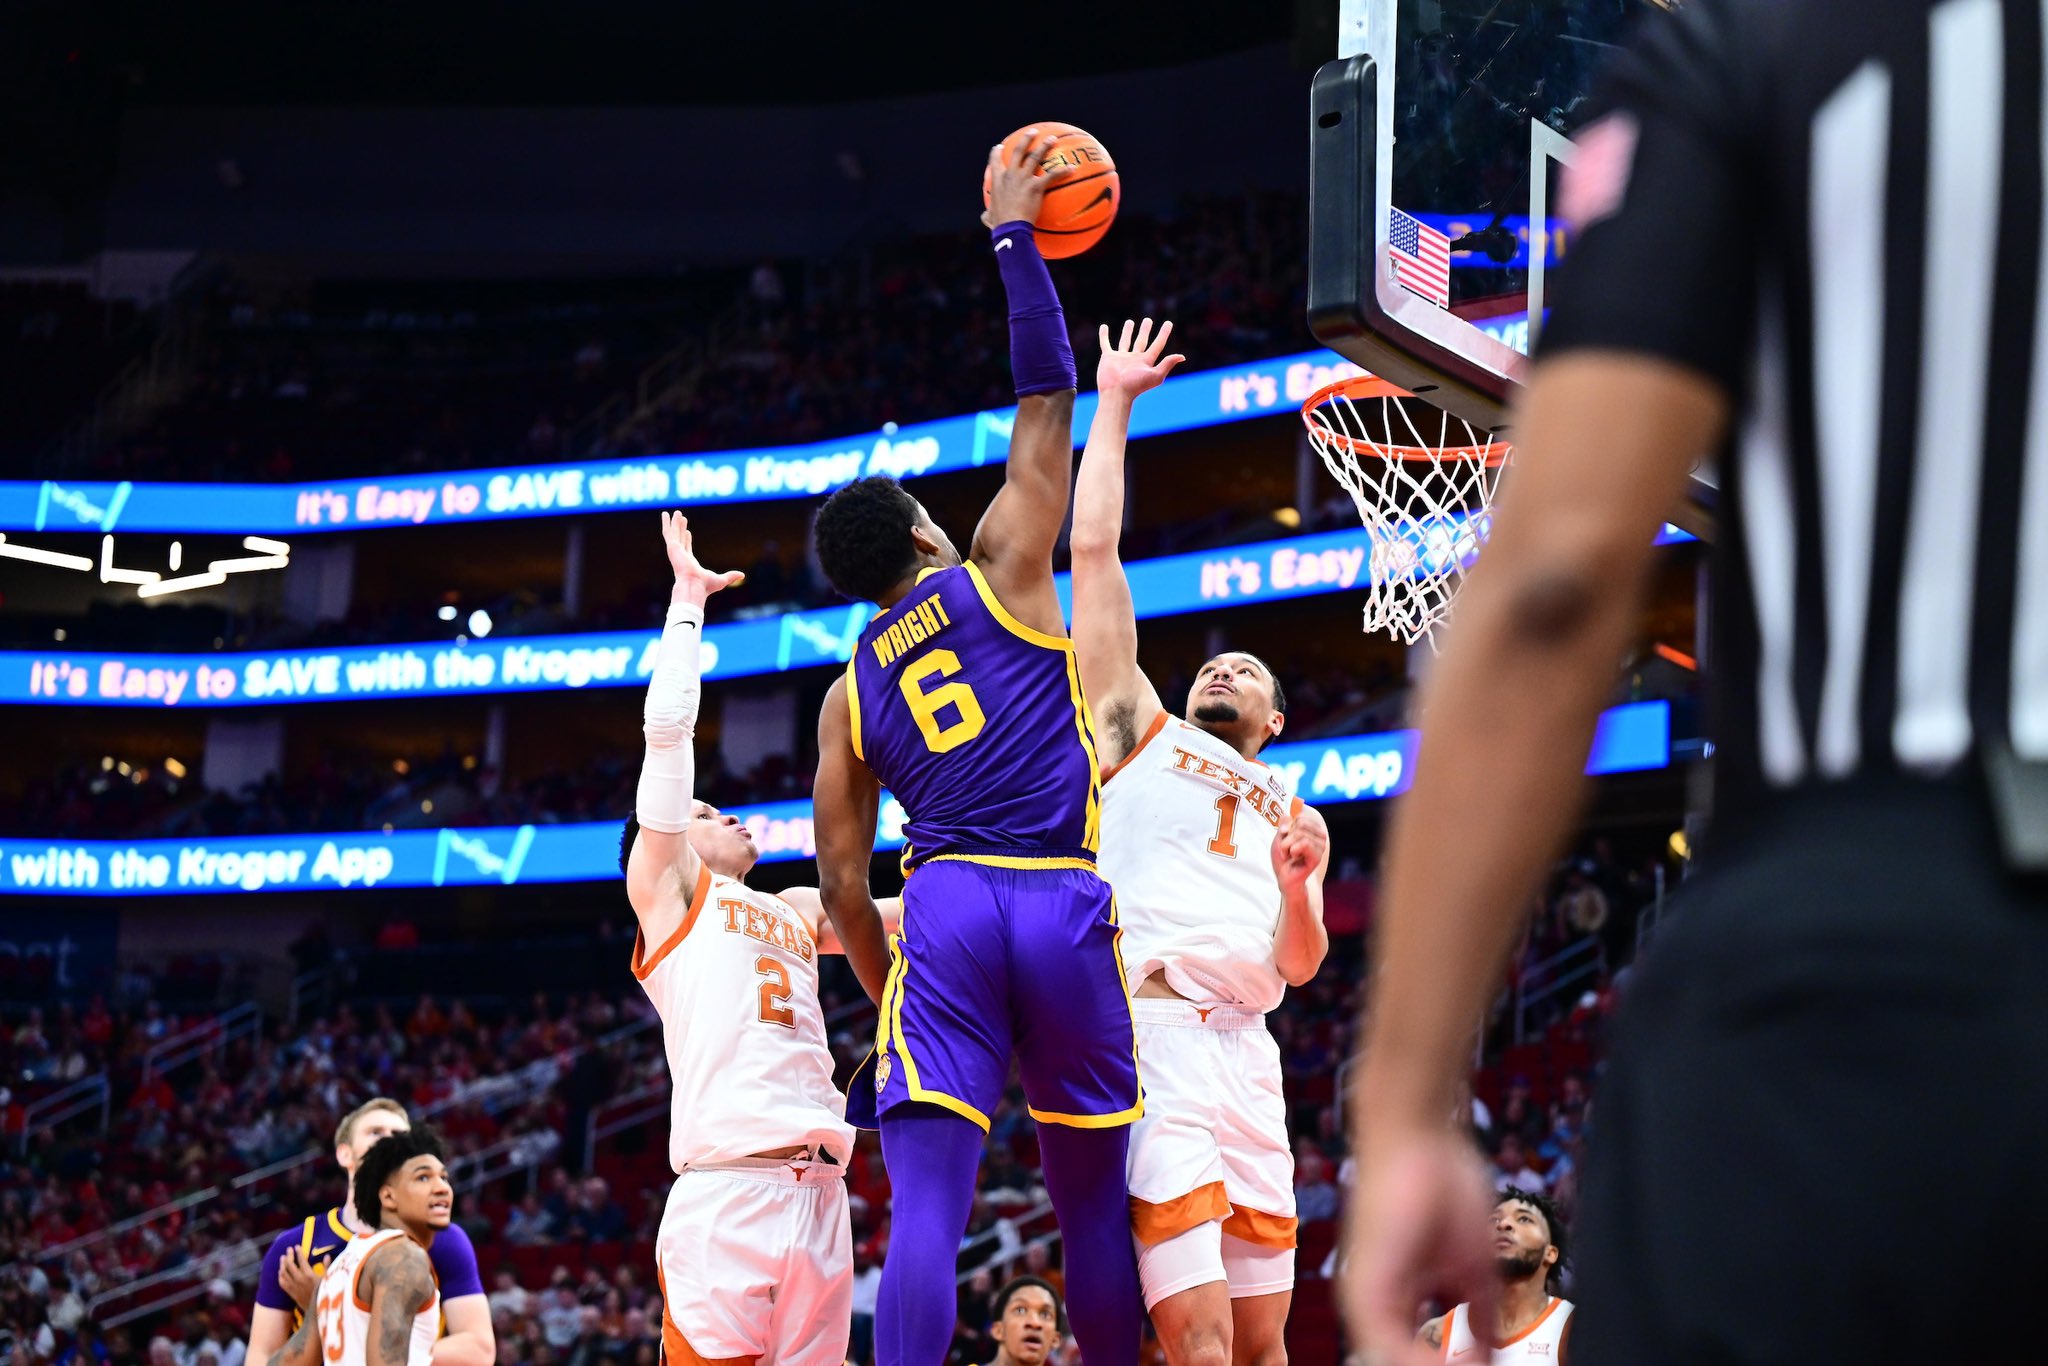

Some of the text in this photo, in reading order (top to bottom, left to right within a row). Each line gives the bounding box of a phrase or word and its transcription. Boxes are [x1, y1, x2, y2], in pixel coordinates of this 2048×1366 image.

[1220, 373, 1277, 412] It's
[296, 437, 940, 524] It's Easy to SAVE with the Kroger App
[1200, 557, 1261, 599] It's
[1270, 547, 1364, 590] Easy
[871, 592, 951, 669] WRIGHT
[30, 661, 88, 697] It's
[99, 662, 189, 705] Easy
[196, 665, 236, 698] to
[244, 656, 340, 697] SAVE
[347, 652, 426, 691] with
[434, 650, 495, 687] the
[503, 647, 632, 686] Kroger
[899, 648, 987, 753] 6
[1173, 745, 1288, 829] TEXAS
[1313, 750, 1404, 800] App
[1207, 791, 1241, 859] 1
[12, 843, 393, 890] with the Kroger App
[717, 897, 813, 963] TEXAS
[754, 954, 796, 1029] 2
